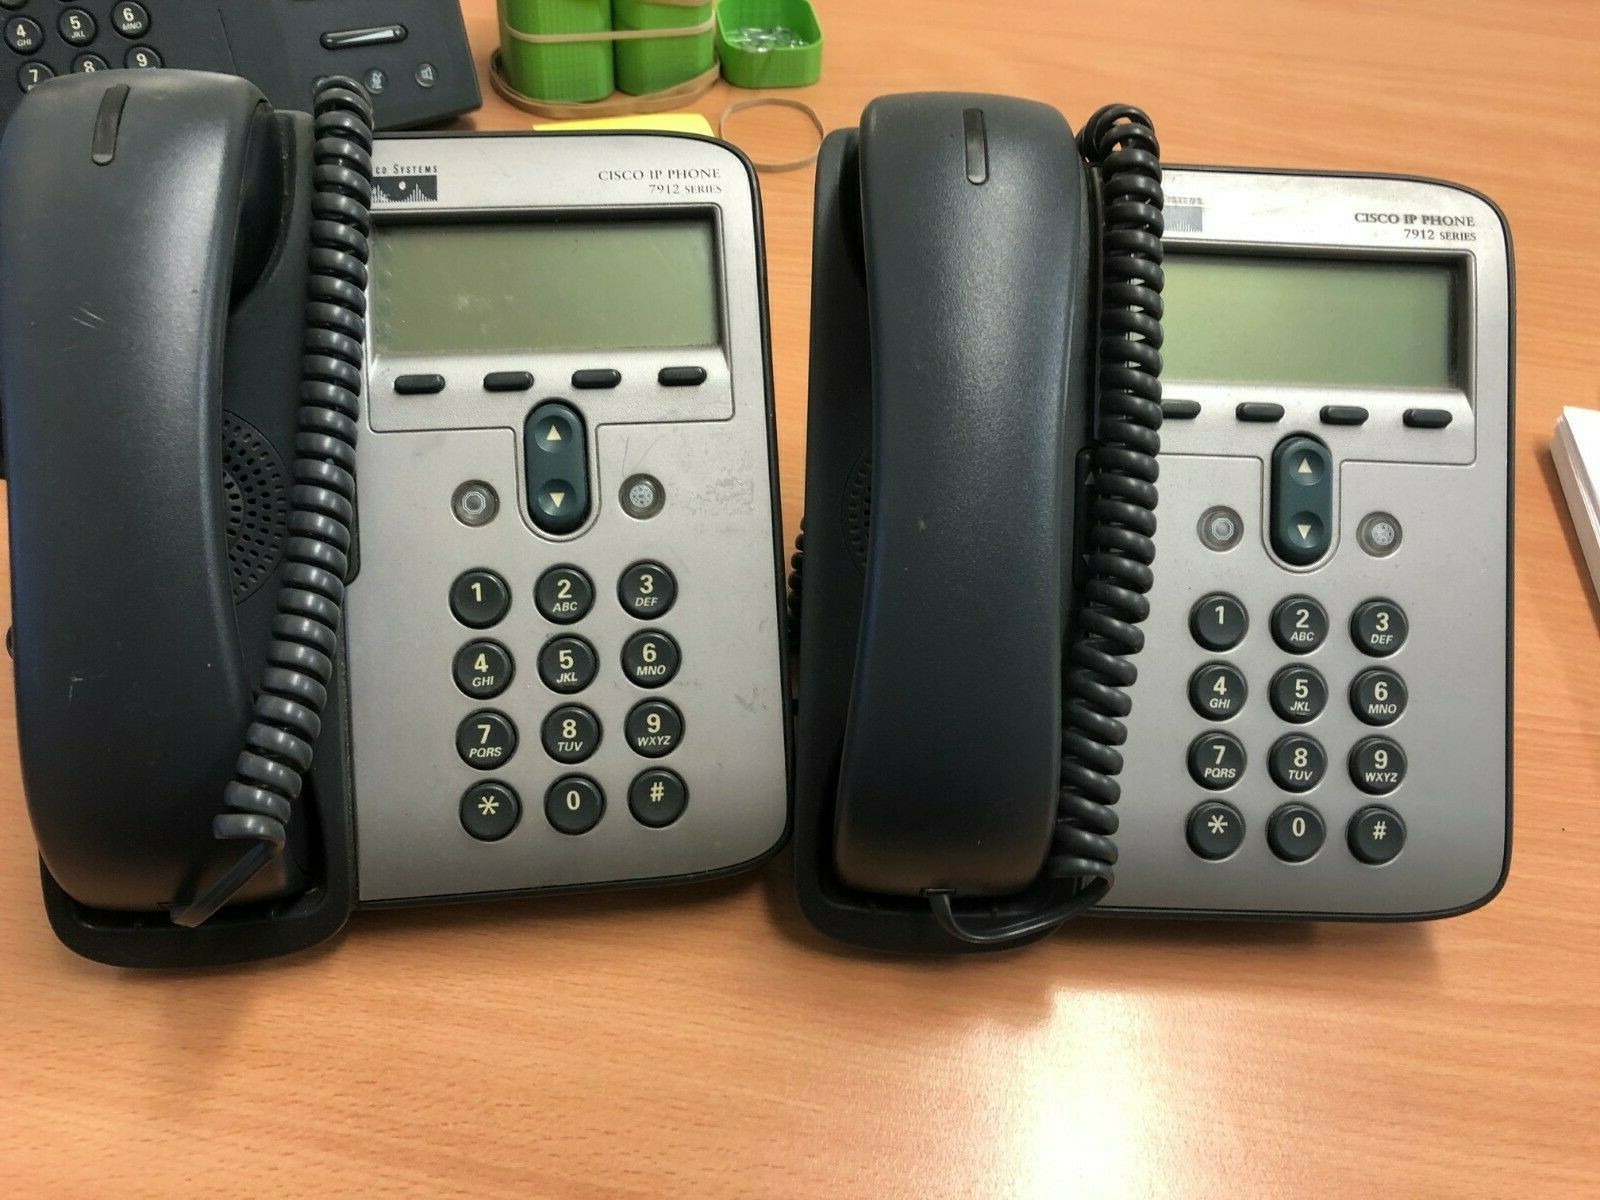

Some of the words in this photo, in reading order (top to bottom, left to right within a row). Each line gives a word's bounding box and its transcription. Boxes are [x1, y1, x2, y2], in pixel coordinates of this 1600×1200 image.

[123, 7, 134, 22] 6
[70, 15, 81, 30] 5
[16, 24, 27, 37] 4
[136, 53, 147, 67] 9
[29, 69, 38, 83] 7
[393, 164, 438, 174] SYSTEMS
[598, 169, 644, 181] CISCO
[650, 169, 662, 180] IP
[668, 168, 721, 180] PHONE
[649, 184, 679, 195] 7912
[684, 184, 722, 194] SERIES
[1354, 212, 1400, 224] CISCO
[1403, 214, 1418, 224] IP
[1421, 214, 1476, 227] PHONE
[1403, 228, 1435, 240] 7912
[1439, 231, 1477, 241] SERIES
[557, 580, 572, 599] 2
[640, 575, 653, 594] 3
[471, 583, 482, 602] 1
[553, 602, 578, 612] ABC
[635, 598, 658, 607] DEF
[1215, 606, 1224, 624] 1
[1296, 609, 1309, 628] 2
[1376, 612, 1389, 631] 3
[1291, 632, 1315, 641] ABC
[1371, 634, 1393, 644] DEF
[559, 650, 574, 669] 5
[643, 643, 656, 662] 6
[474, 654, 488, 673] 4
[637, 666, 666, 675] MNO
[473, 677, 494, 687] GHI
[557, 674, 578, 683] JKL
[1213, 676, 1227, 695] 4
[1295, 679, 1308, 698] 5
[1374, 682, 1388, 701] 6
[1209, 698, 1230, 708] GHI
[1290, 702, 1310, 711] JKL
[1368, 704, 1397, 714] MNO
[563, 719, 576, 738] 8
[647, 714, 661, 733] 9
[478, 724, 491, 744] 7
[638, 736, 671, 746] WXYZ
[469, 748, 502, 758] PQRS
[557, 742, 583, 752] TUV
[1213, 745, 1226, 764] 7
[1294, 748, 1308, 767] 8
[1374, 750, 1388, 769] 9
[1204, 768, 1236, 778] PQRS
[1288, 771, 1313, 780] TUV
[1365, 773, 1398, 782] WXYZ
[650, 782, 664, 801] #
[566, 791, 580, 810] 0
[1292, 817, 1305, 837] 0
[1373, 821, 1387, 840] #
